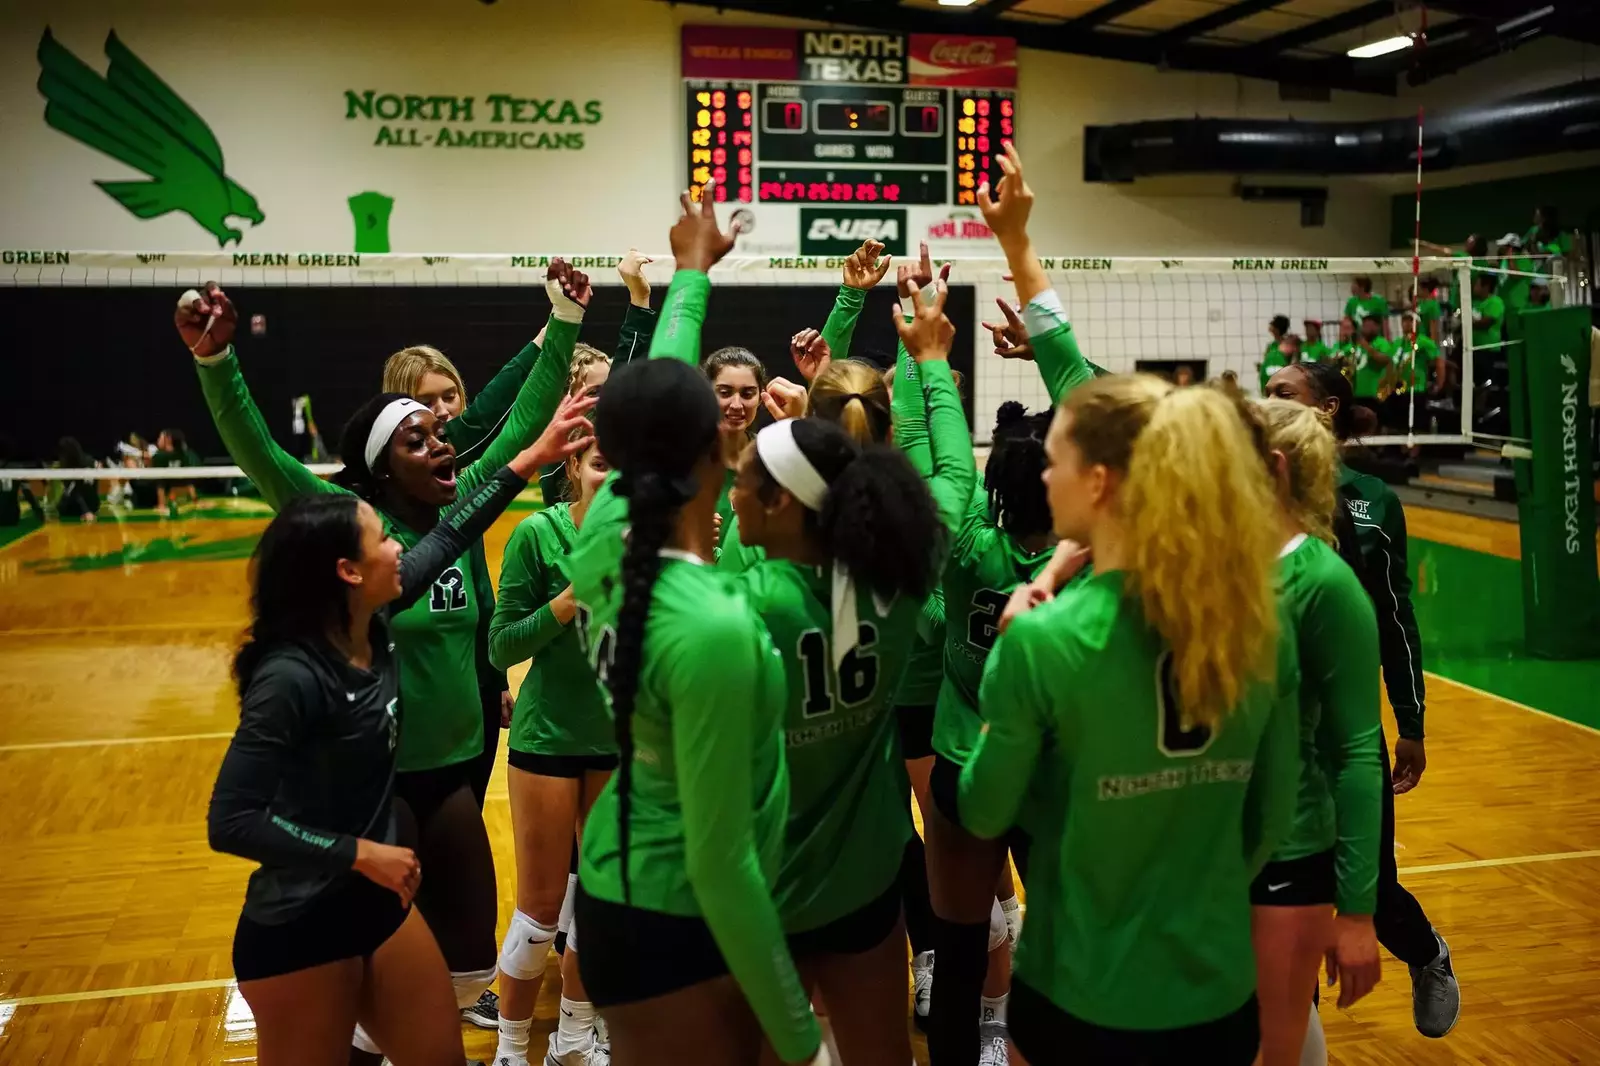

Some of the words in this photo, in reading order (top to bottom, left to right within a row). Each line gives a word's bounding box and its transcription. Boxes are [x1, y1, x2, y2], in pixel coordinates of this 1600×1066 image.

[804, 33, 903, 56] NORTH
[804, 57, 903, 81] TEXAS
[344, 90, 475, 122] NORTH
[486, 94, 602, 124] TEXAS
[784, 102, 802, 130] 0
[921, 106, 938, 134] 0
[374, 126, 585, 150] ALL-AMERICANS
[865, 145, 894, 158] WON
[2, 251, 70, 265] GREEN
[232, 254, 289, 266] MEAN
[297, 254, 361, 267] GREEN
[511, 256, 551, 268] MEA
[769, 258, 818, 269] MEAN
[1061, 259, 1112, 270] GREEN
[1232, 260, 1275, 270] MEAN
[1281, 260, 1329, 270] GREEN
[1562, 381, 1579, 474] NORTH
[1565, 475, 1581, 555] TEXAS
[430, 566, 468, 612] 12
[796, 620, 880, 719] 16
